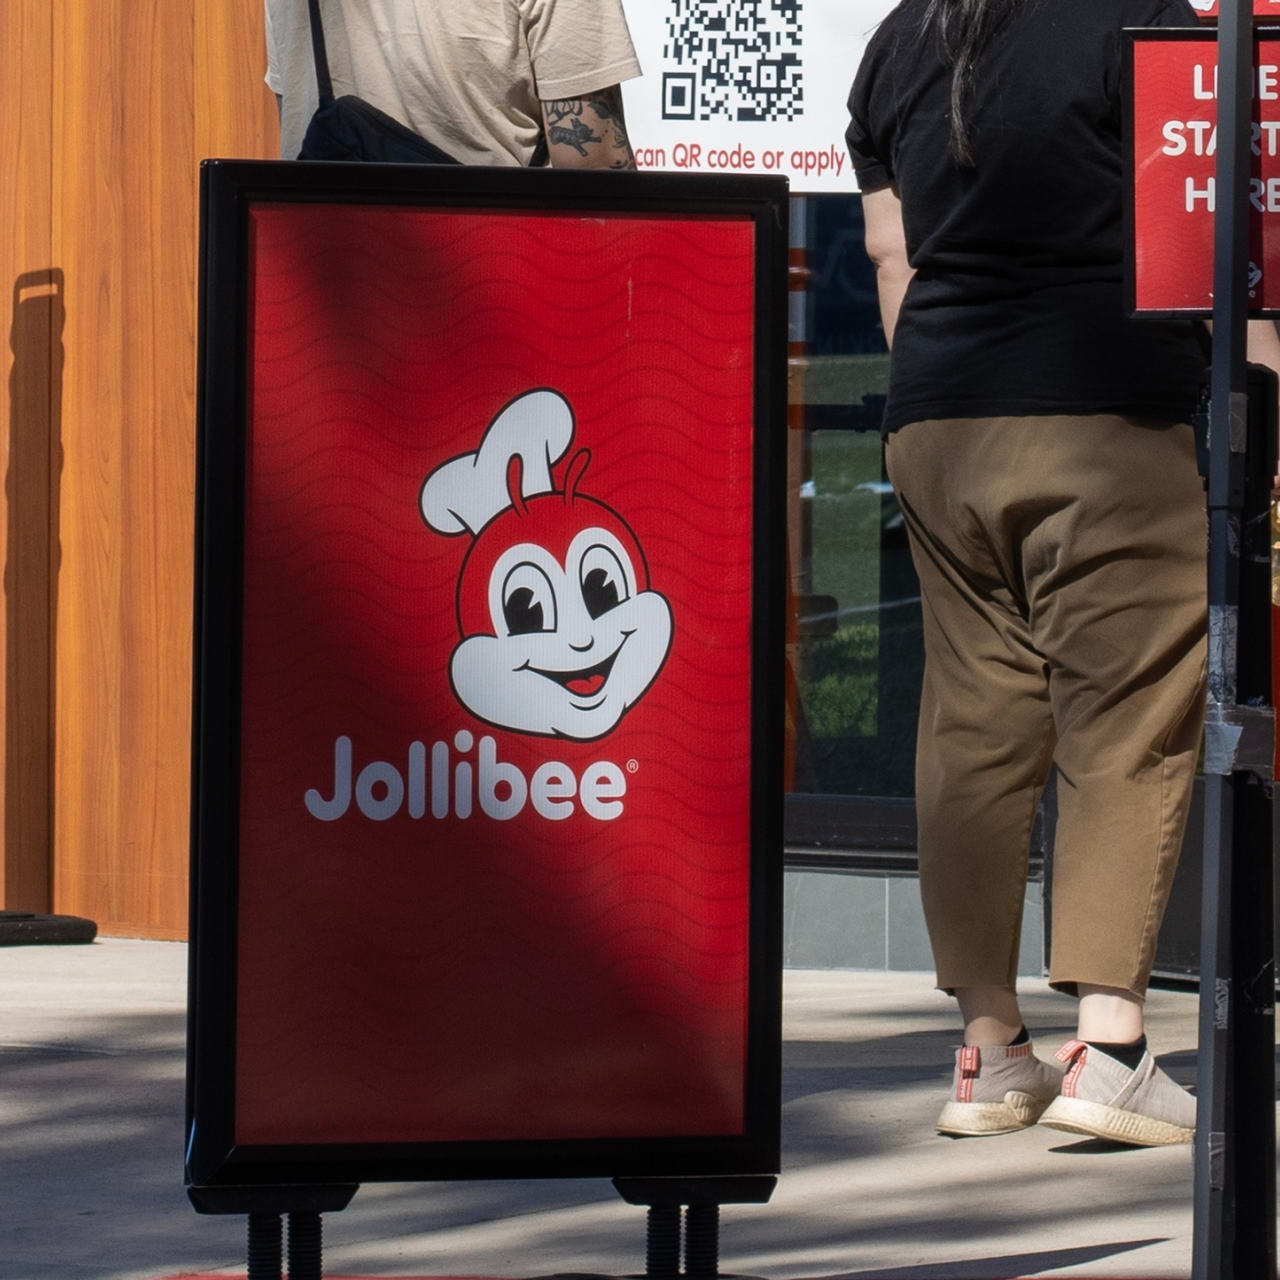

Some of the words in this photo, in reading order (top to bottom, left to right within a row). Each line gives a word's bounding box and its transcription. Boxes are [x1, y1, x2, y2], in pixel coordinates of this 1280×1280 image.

[1193, 64, 1279, 100] LE
[632, 147, 666, 168] can
[672, 142, 702, 169] QR
[707, 142, 756, 170] code
[762, 149, 785, 170] or
[790, 143, 846, 177] apply
[304, 728, 628, 822] Jollibee
